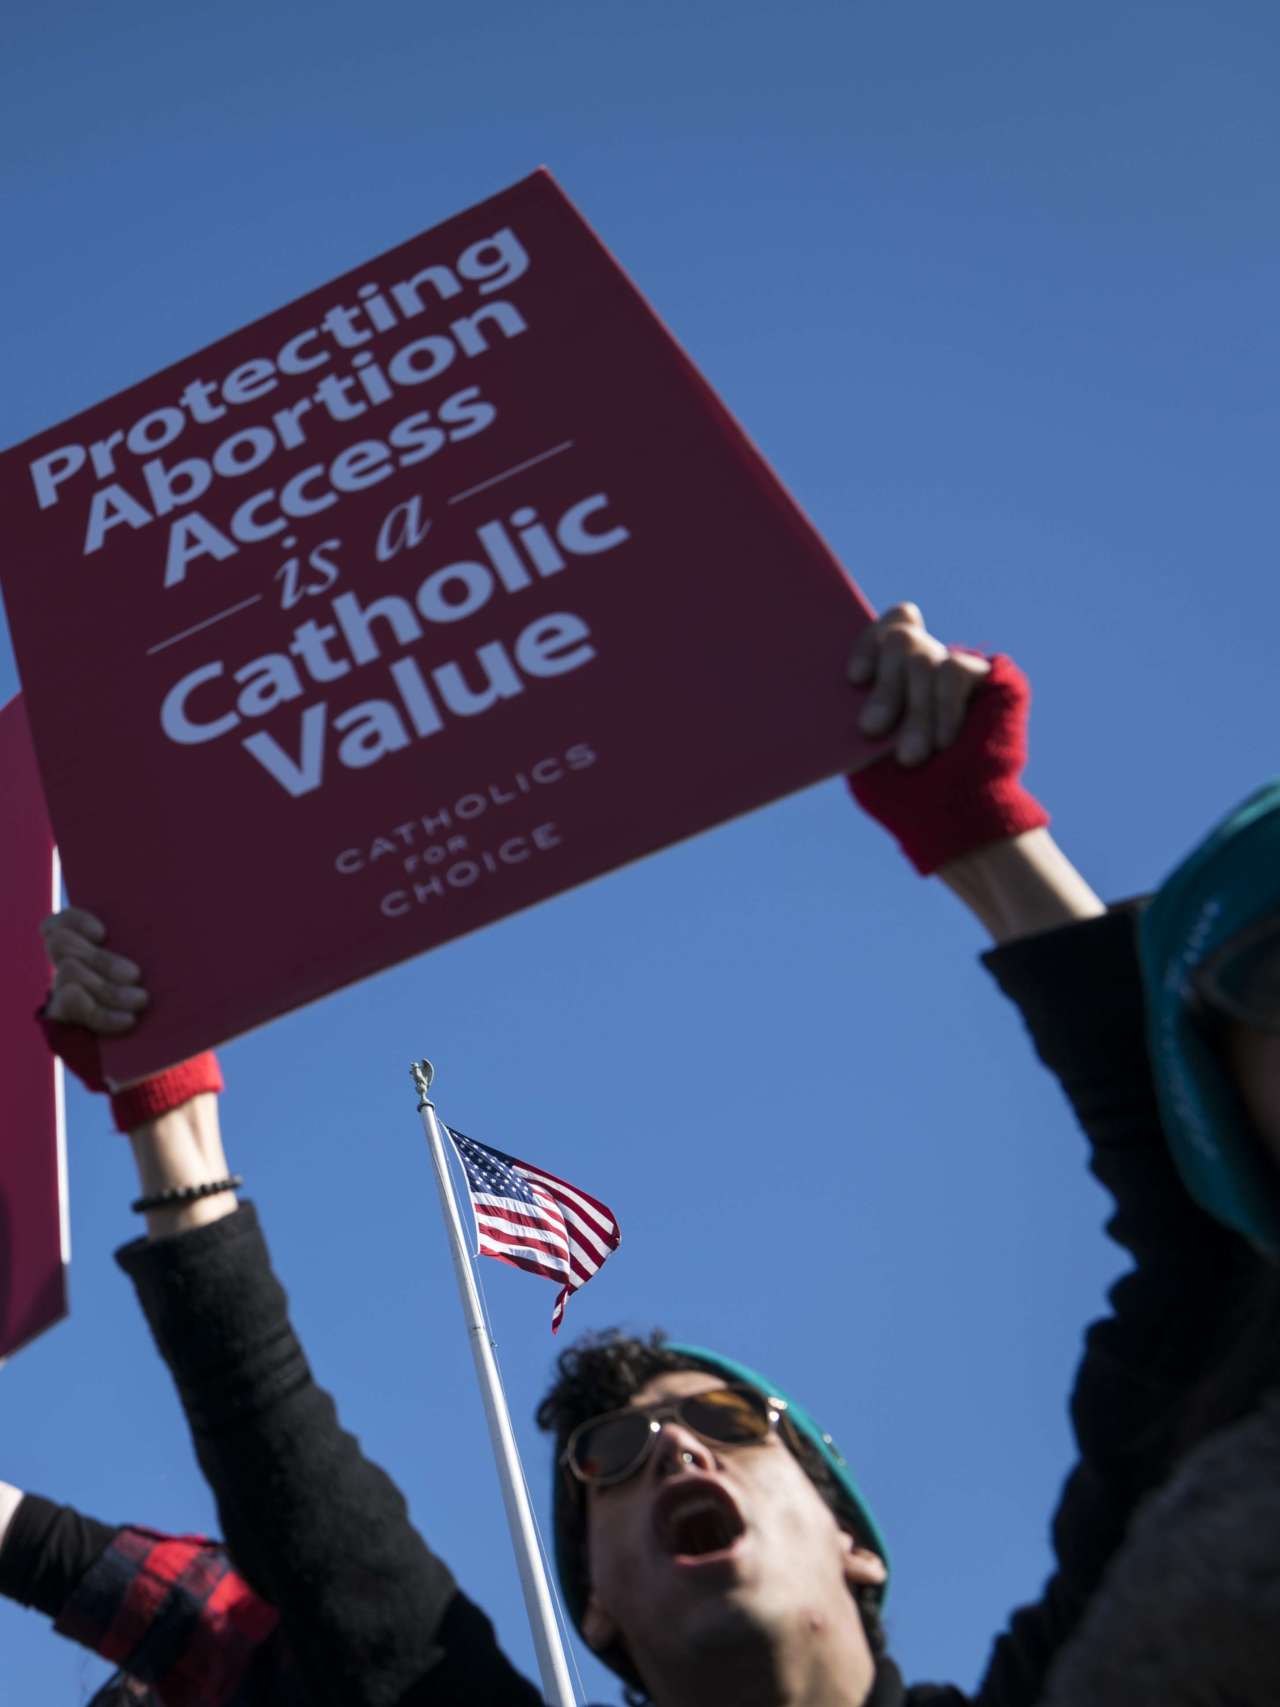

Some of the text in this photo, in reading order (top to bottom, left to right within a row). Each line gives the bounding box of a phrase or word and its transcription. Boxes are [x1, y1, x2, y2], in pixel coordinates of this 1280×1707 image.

[30, 226, 531, 509] Protecting
[82, 300, 528, 556] Abortion
[162, 386, 497, 588] Access
[273, 494, 431, 610] is a
[160, 493, 631, 747] Catholic
[241, 611, 596, 797] Value
[334, 743, 597, 875] CATHOLICS
[380, 822, 563, 917] CHOICE
[404, 836, 468, 873] FOR
